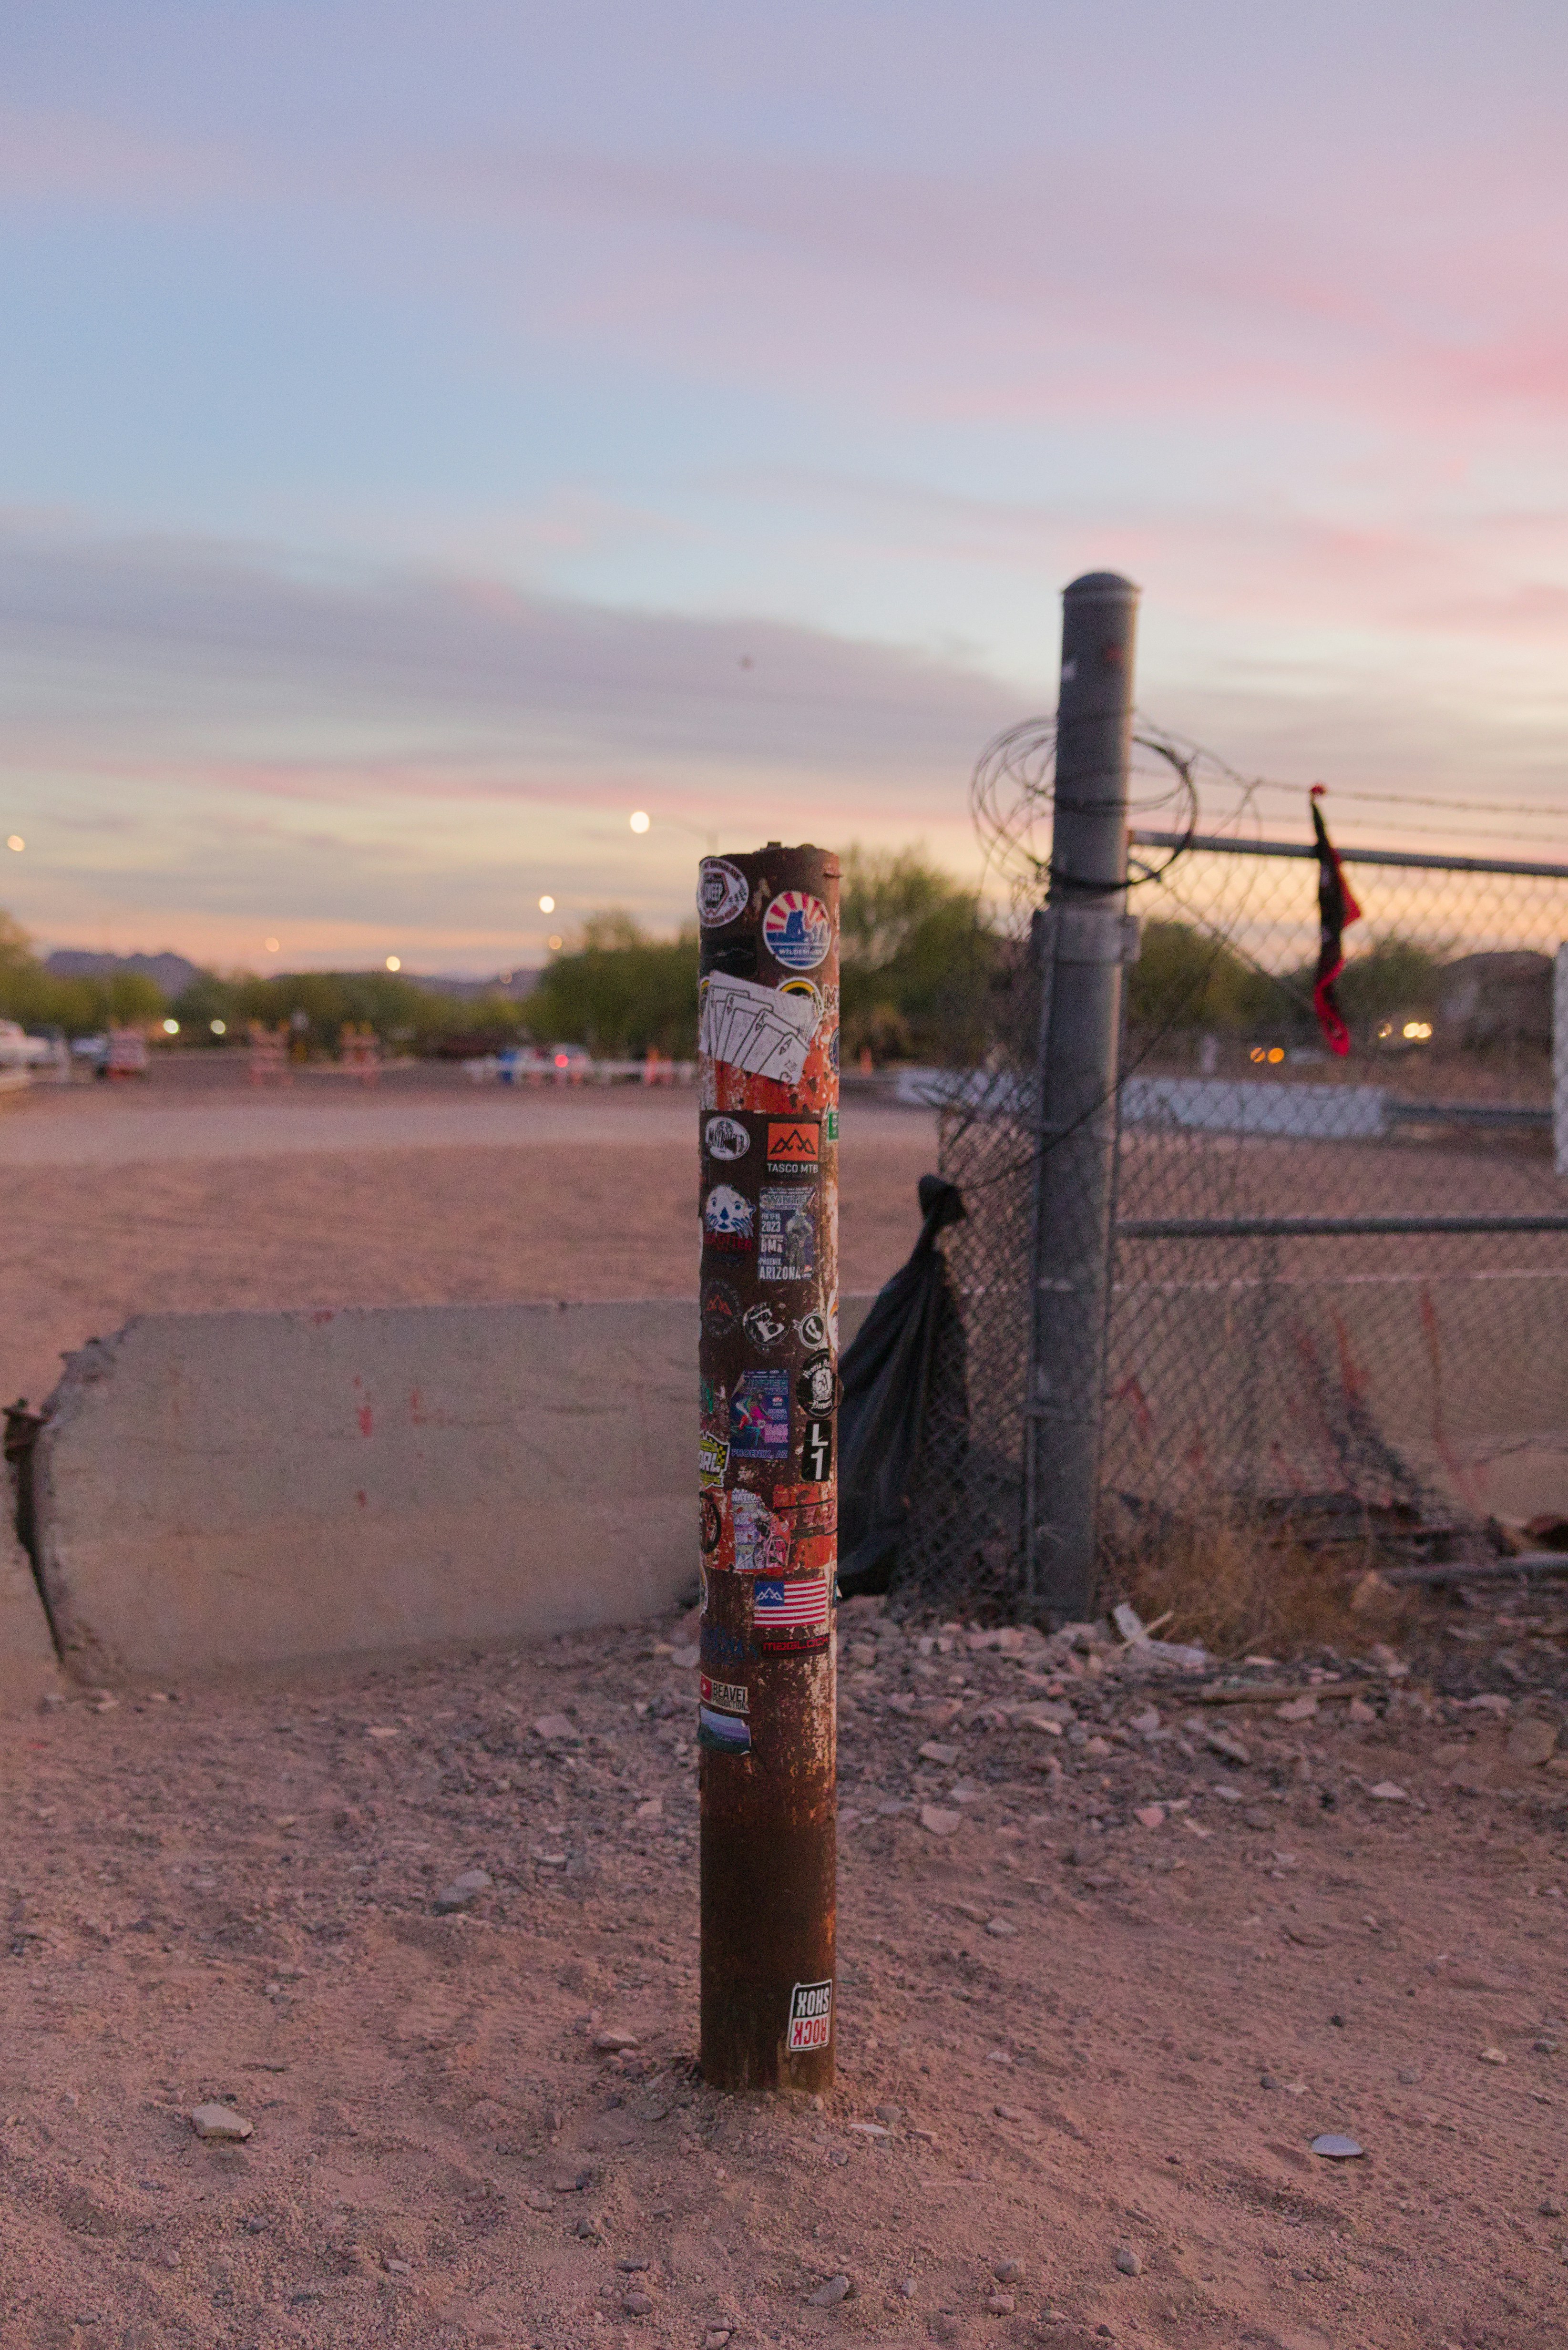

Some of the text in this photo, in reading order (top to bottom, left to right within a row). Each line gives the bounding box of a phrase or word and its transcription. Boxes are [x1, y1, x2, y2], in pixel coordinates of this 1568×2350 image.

[767, 1162, 819, 1173] TASCO MTB
[761, 1221, 780, 1232] 2023
[759, 1266, 801, 1280] ARIZONA
[775, 1449, 788, 1459] AZ
[797, 1987, 830, 2016] SHOX
[793, 2017, 827, 2045] ROCK
